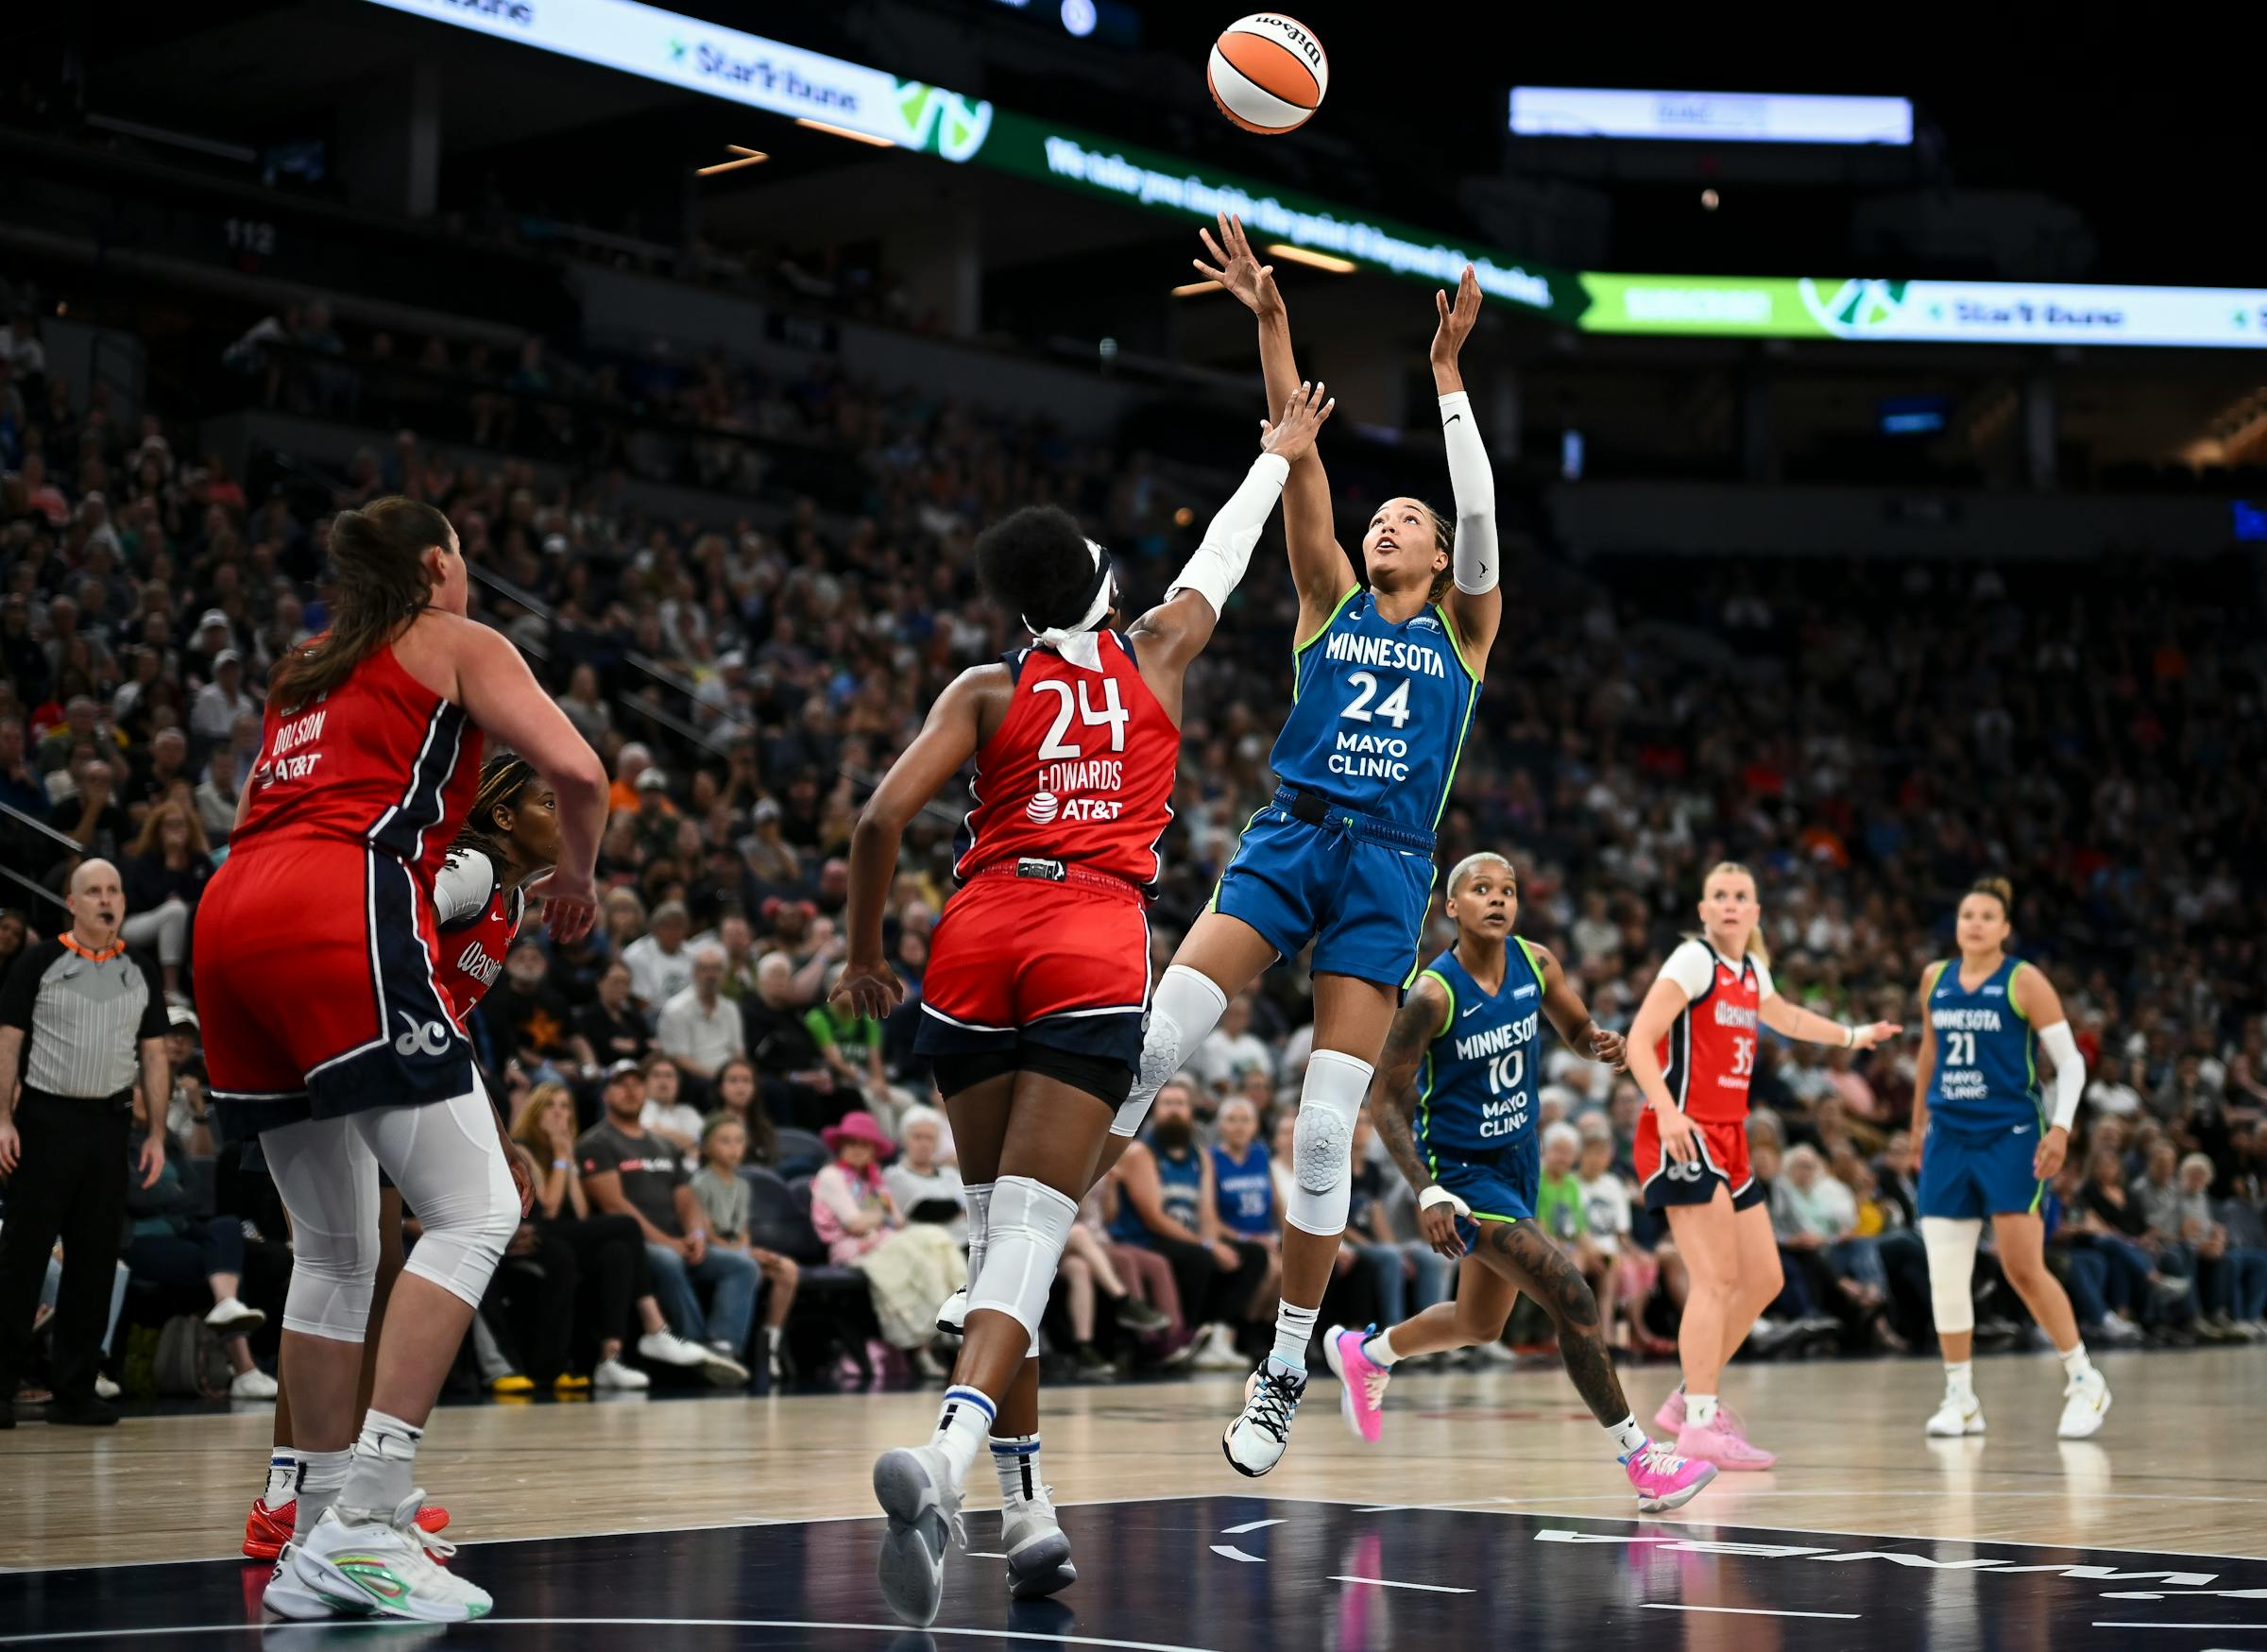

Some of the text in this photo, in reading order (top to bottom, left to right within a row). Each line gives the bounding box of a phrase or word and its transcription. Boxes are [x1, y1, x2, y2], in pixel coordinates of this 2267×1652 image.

[1255, 17, 1321, 68] Wilson
[1325, 632, 1444, 678] MINNESOTA
[1340, 671, 1410, 729] 24
[272, 710, 327, 757] DOLSON
[1032, 677, 1130, 760] 24
[1337, 731, 1407, 758] MAYO
[275, 754, 322, 780] AT&T
[1038, 760, 1122, 792] EDWARDS
[1328, 754, 1409, 781] CLINIC
[1062, 798, 1123, 821] AT&T
[1730, 1035, 1754, 1076] 35
[1945, 1031, 1976, 1066] 21
[1489, 1049, 1524, 1095] 10
[1941, 1069, 1984, 1085] MAYO
[1482, 1091, 1527, 1119] MAYO
